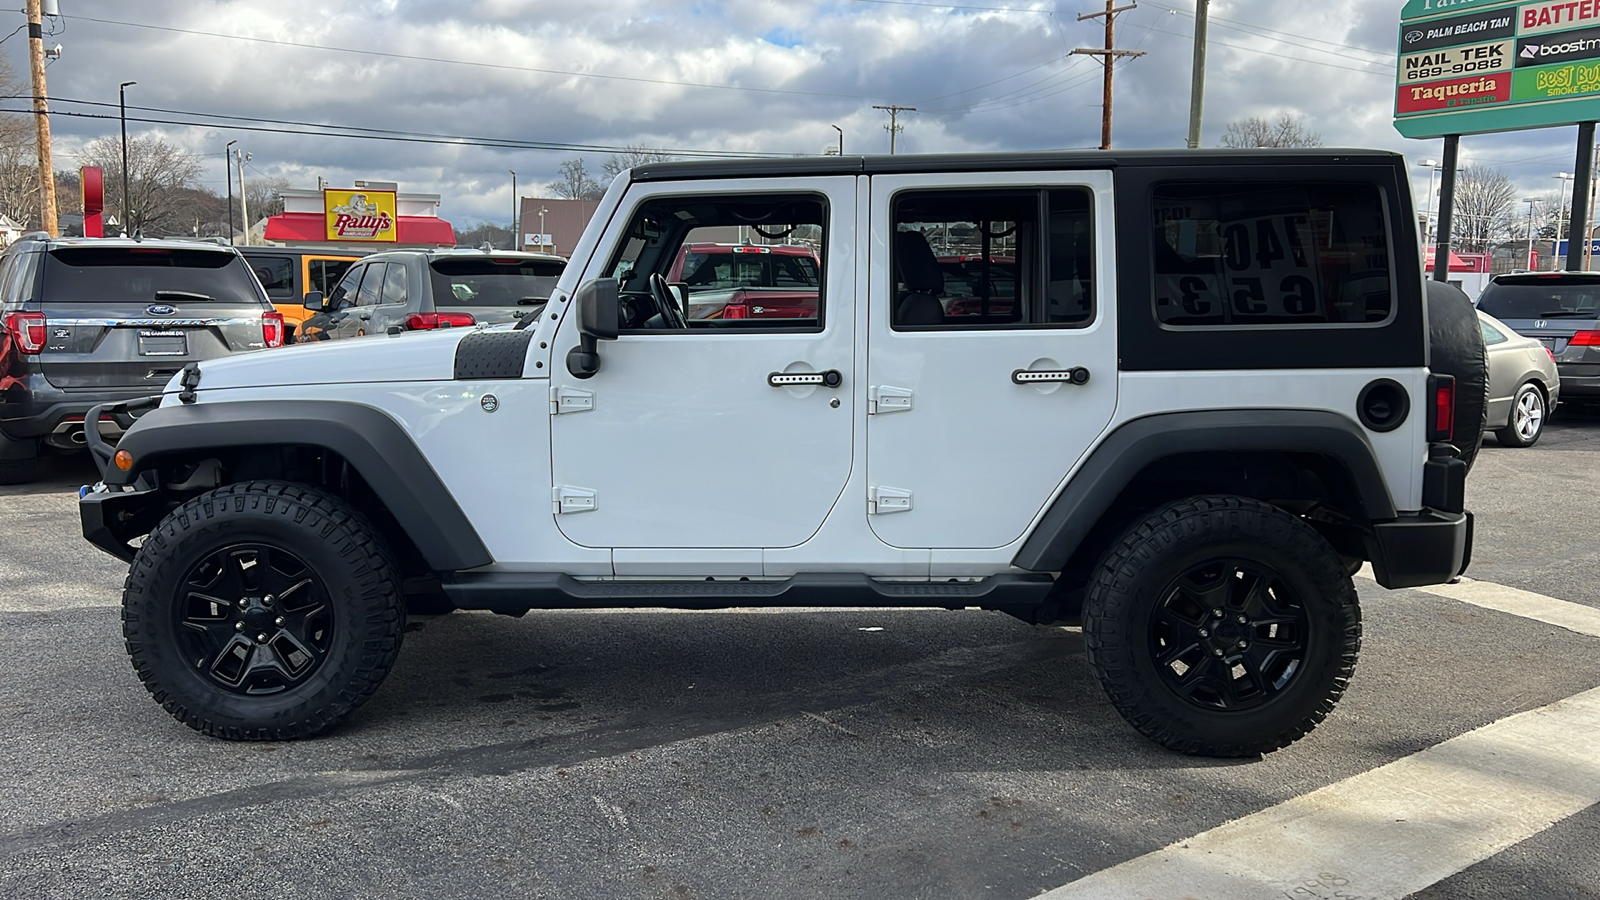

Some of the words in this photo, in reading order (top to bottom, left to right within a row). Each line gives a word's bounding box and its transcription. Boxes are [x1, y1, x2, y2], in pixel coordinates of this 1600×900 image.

[1427, 26, 1453, 39] PALM
[1454, 21, 1488, 35] BEACH
[1490, 17, 1510, 29] TAN
[1406, 53, 1451, 69] NAIL
[1461, 43, 1505, 60] TEK
[1407, 58, 1502, 79] 689-9088
[1547, 86, 1579, 96] SMOKE
[333, 212, 392, 236] Rally's
